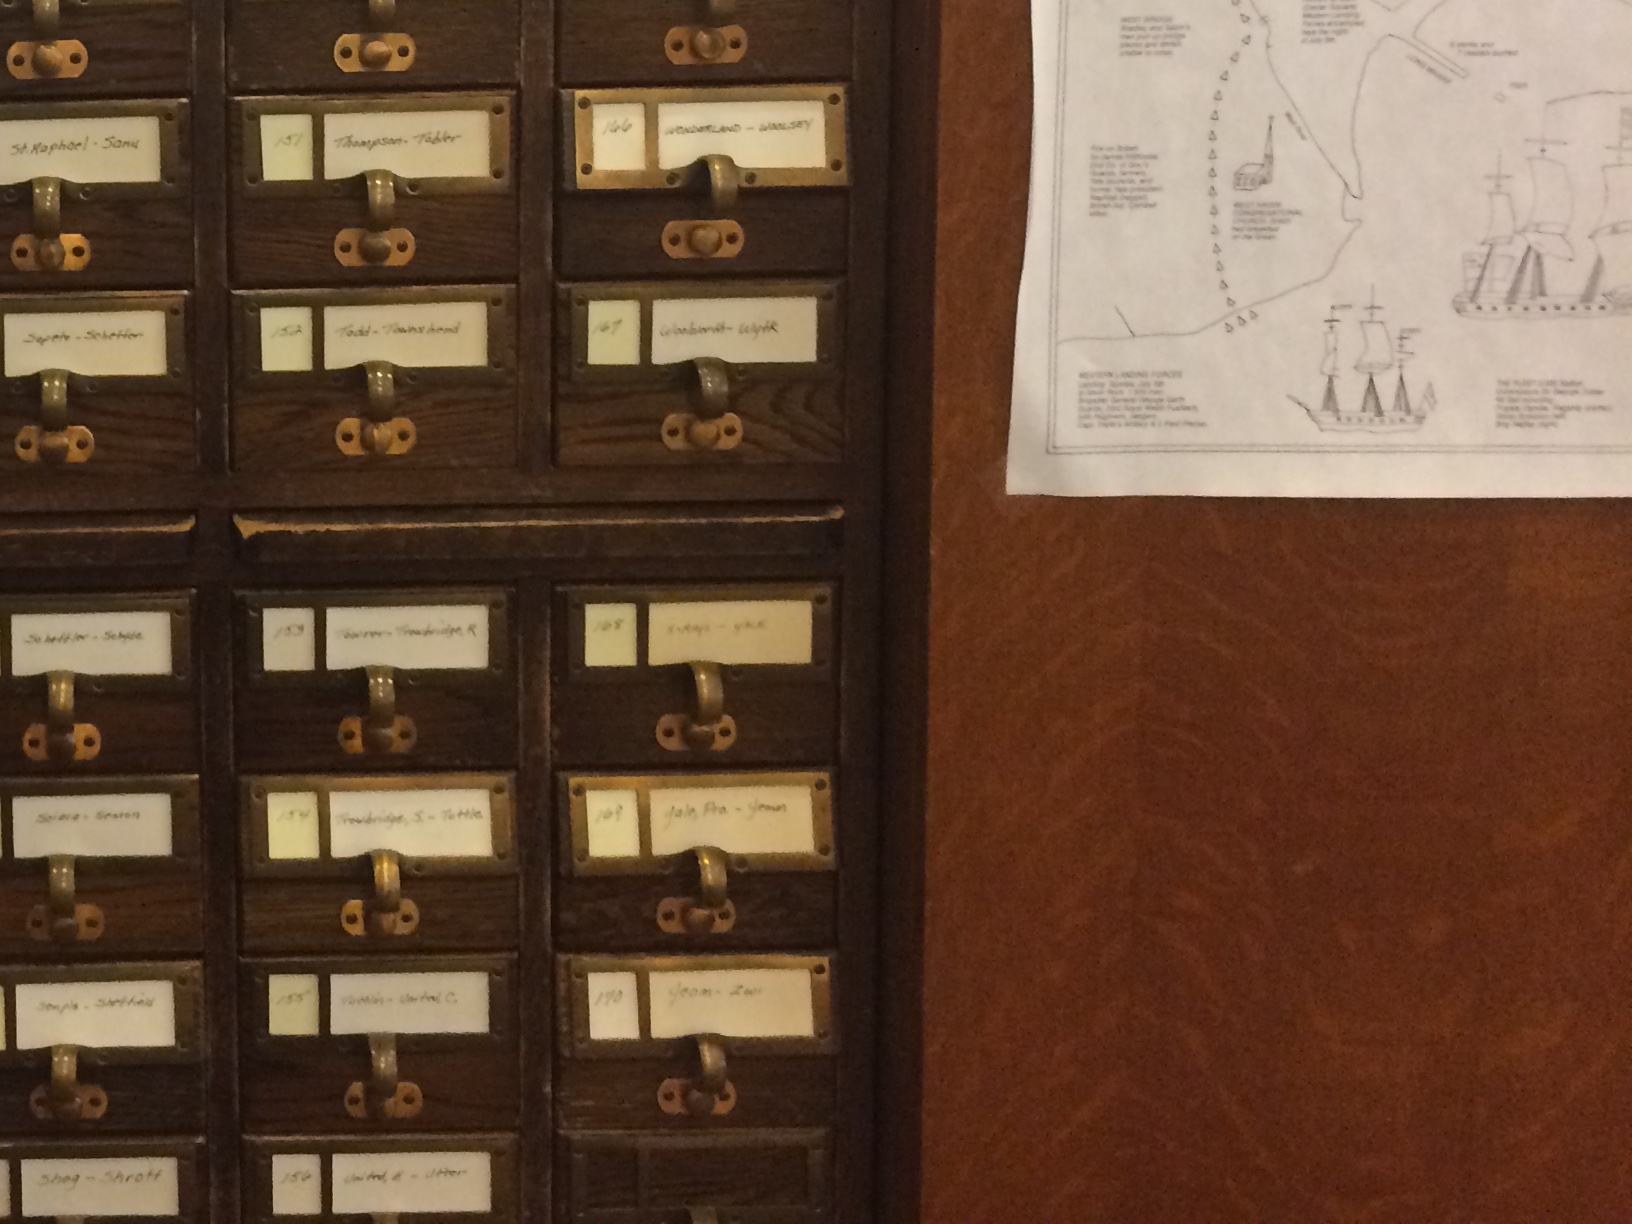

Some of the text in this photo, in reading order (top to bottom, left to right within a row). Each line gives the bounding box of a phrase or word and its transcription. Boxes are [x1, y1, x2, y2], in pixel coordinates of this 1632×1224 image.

[602, 116, 634, 135] 166
[29, 135, 90, 156] Raphael
[274, 129, 307, 147] 151
[270, 323, 304, 339] 152
